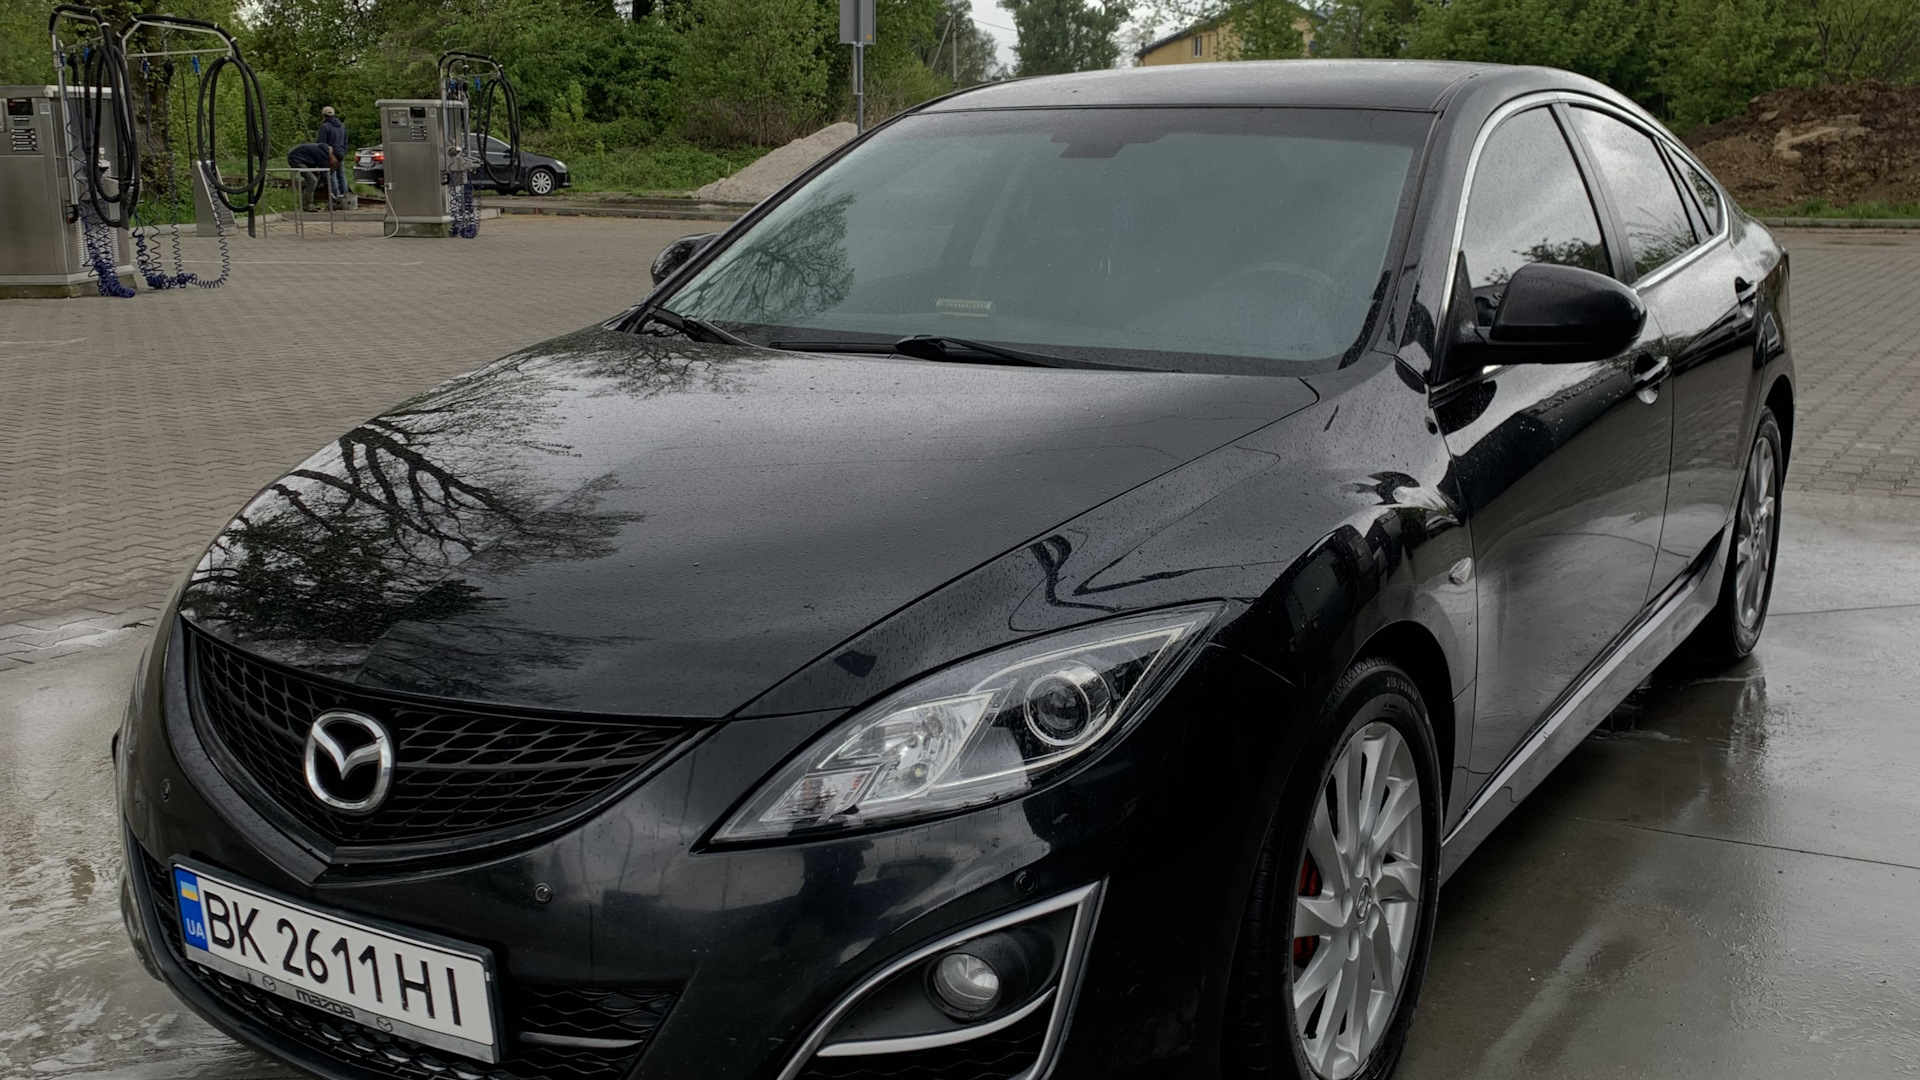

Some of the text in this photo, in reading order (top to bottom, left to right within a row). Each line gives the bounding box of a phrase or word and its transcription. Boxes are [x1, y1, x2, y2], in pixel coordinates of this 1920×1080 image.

[185, 917, 206, 940] UA
[204, 890, 462, 1027] BK 2611 HI
